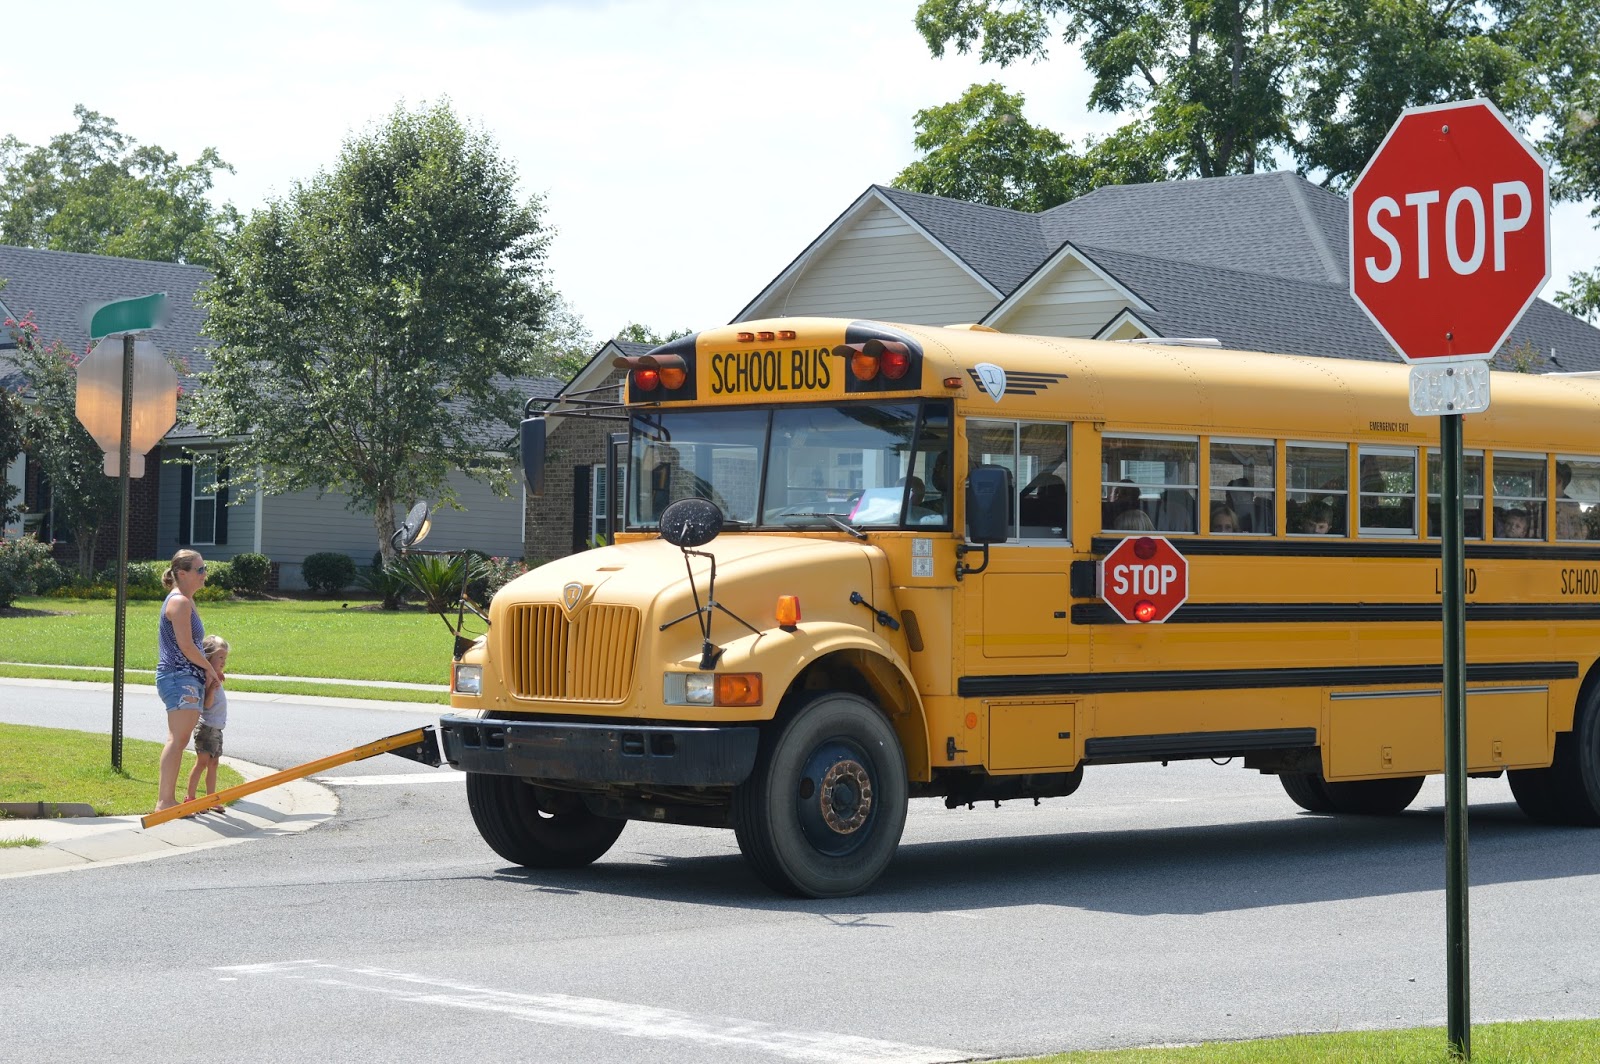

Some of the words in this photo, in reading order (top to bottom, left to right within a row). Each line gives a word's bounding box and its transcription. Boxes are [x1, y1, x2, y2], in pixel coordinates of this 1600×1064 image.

[1365, 180, 1532, 283] STOP
[711, 350, 788, 394] SCHOOL
[791, 347, 831, 390] BUS
[1369, 421, 1398, 432] EMERGENCY
[1398, 422, 1409, 433] EXIT
[1113, 564, 1177, 595] STOP
[1561, 568, 1600, 595] SCHOO
